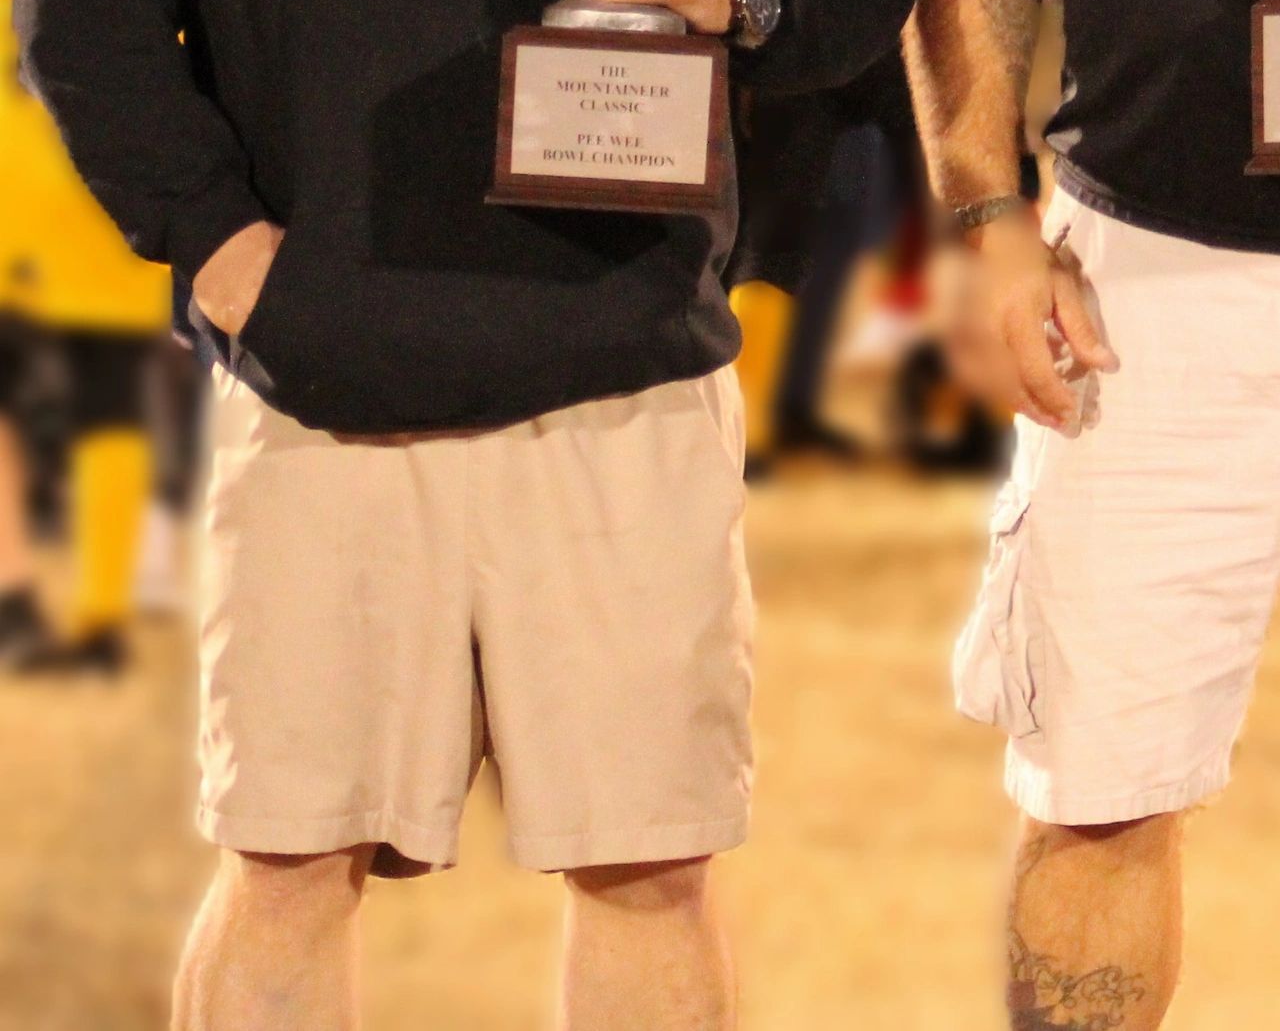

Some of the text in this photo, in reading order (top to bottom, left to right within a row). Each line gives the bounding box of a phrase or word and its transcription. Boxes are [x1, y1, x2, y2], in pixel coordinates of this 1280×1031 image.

[601, 65, 630, 78] THE
[557, 80, 670, 98] MOUNTAINEER
[579, 99, 645, 113] CLASSIC
[577, 133, 644, 148] PEE WEE
[543, 149, 676, 168] BOWL CHAMPION
